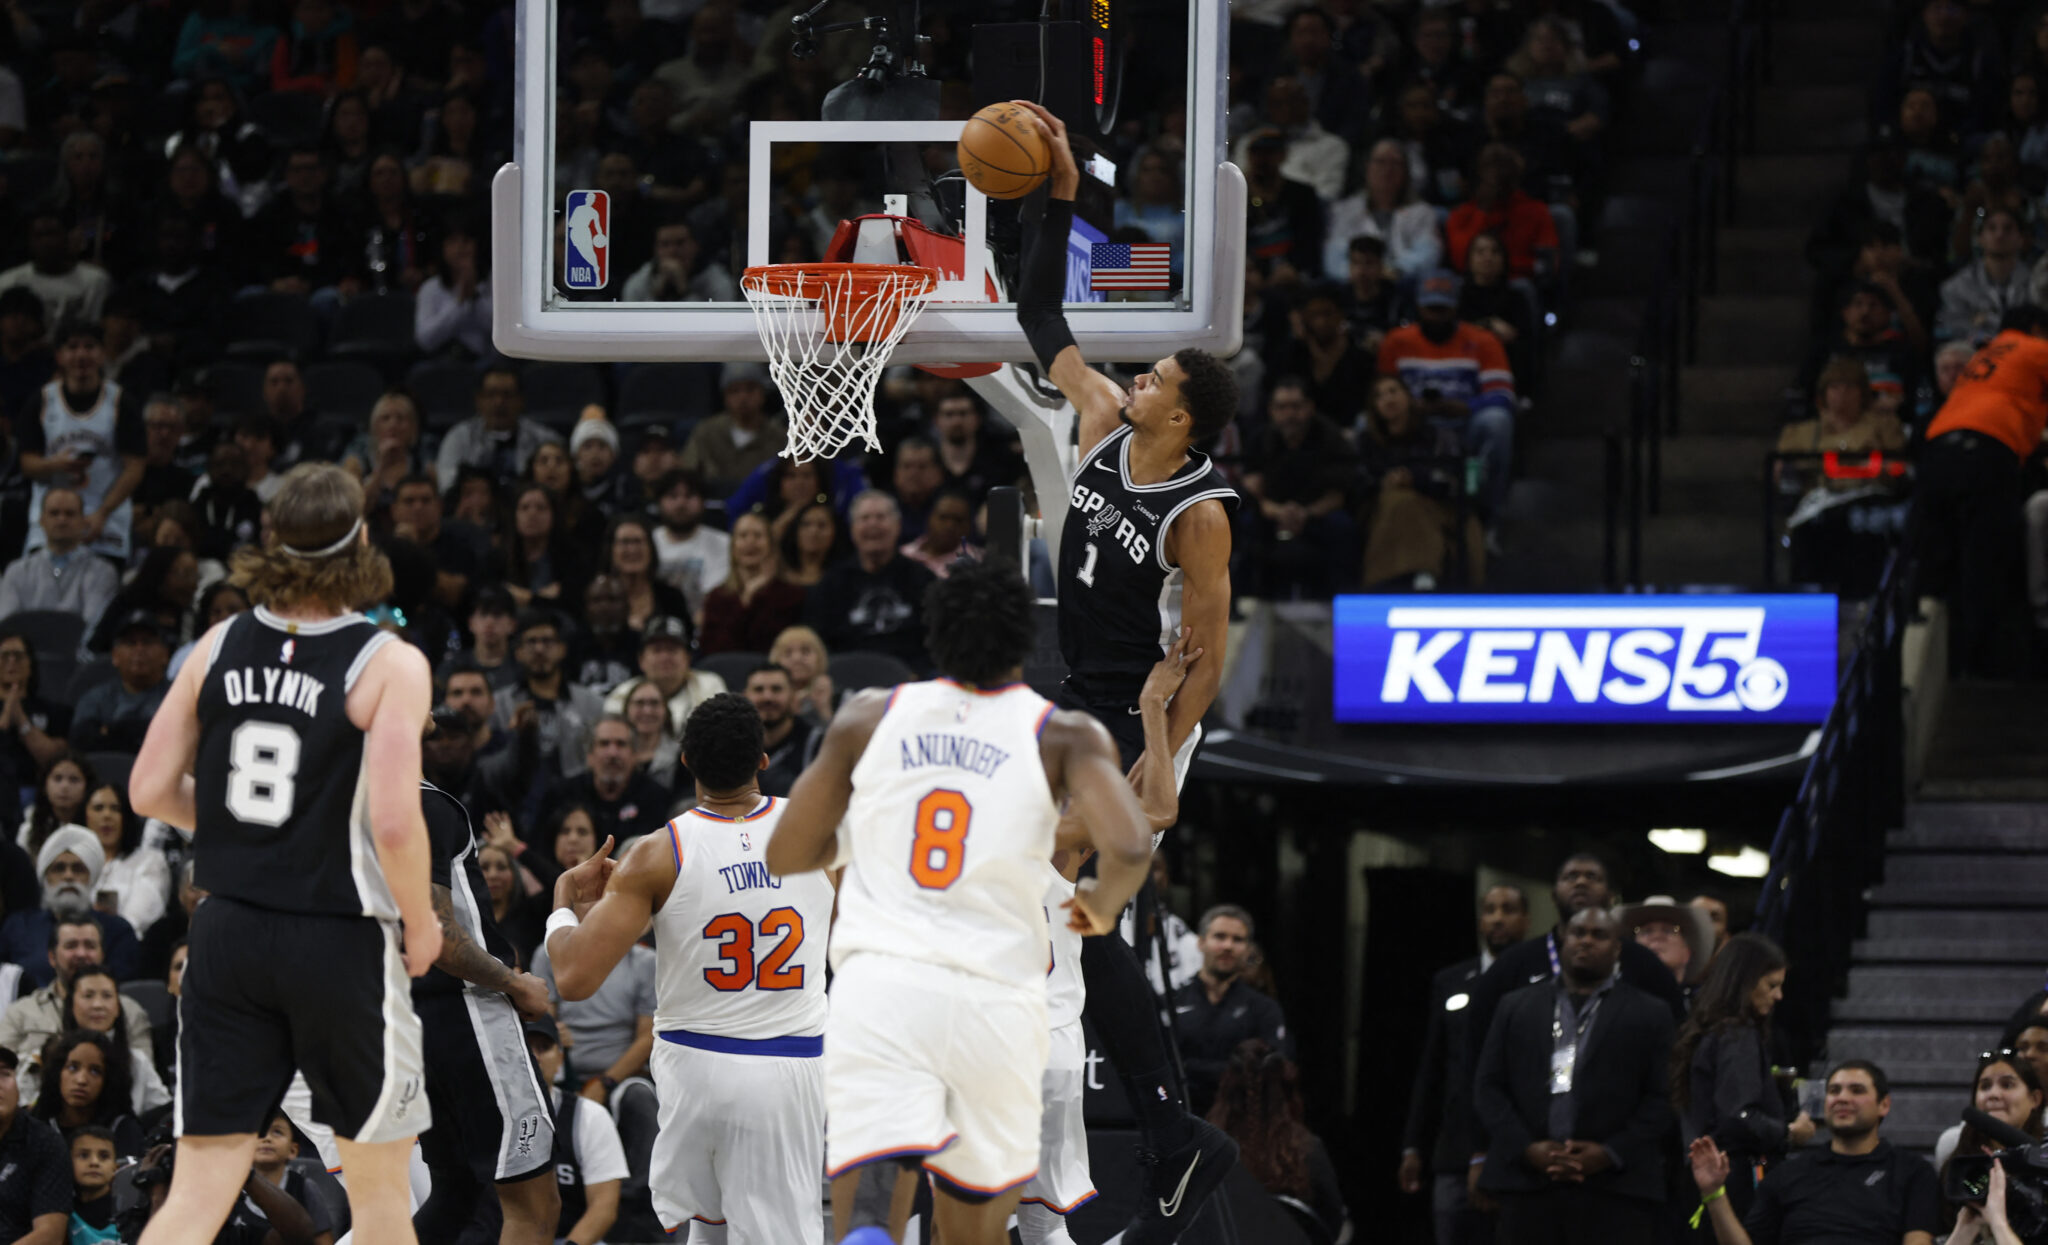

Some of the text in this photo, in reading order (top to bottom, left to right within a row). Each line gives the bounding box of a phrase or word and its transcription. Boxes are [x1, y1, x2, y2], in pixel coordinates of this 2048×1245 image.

[570, 266, 592, 283] NBA
[1076, 541, 1099, 588] 1
[223, 666, 326, 718] OLYNYK
[224, 718, 303, 828] 8
[901, 733, 1011, 779] ANUNOBY
[909, 787, 973, 891] 8
[702, 905, 805, 993] 32
